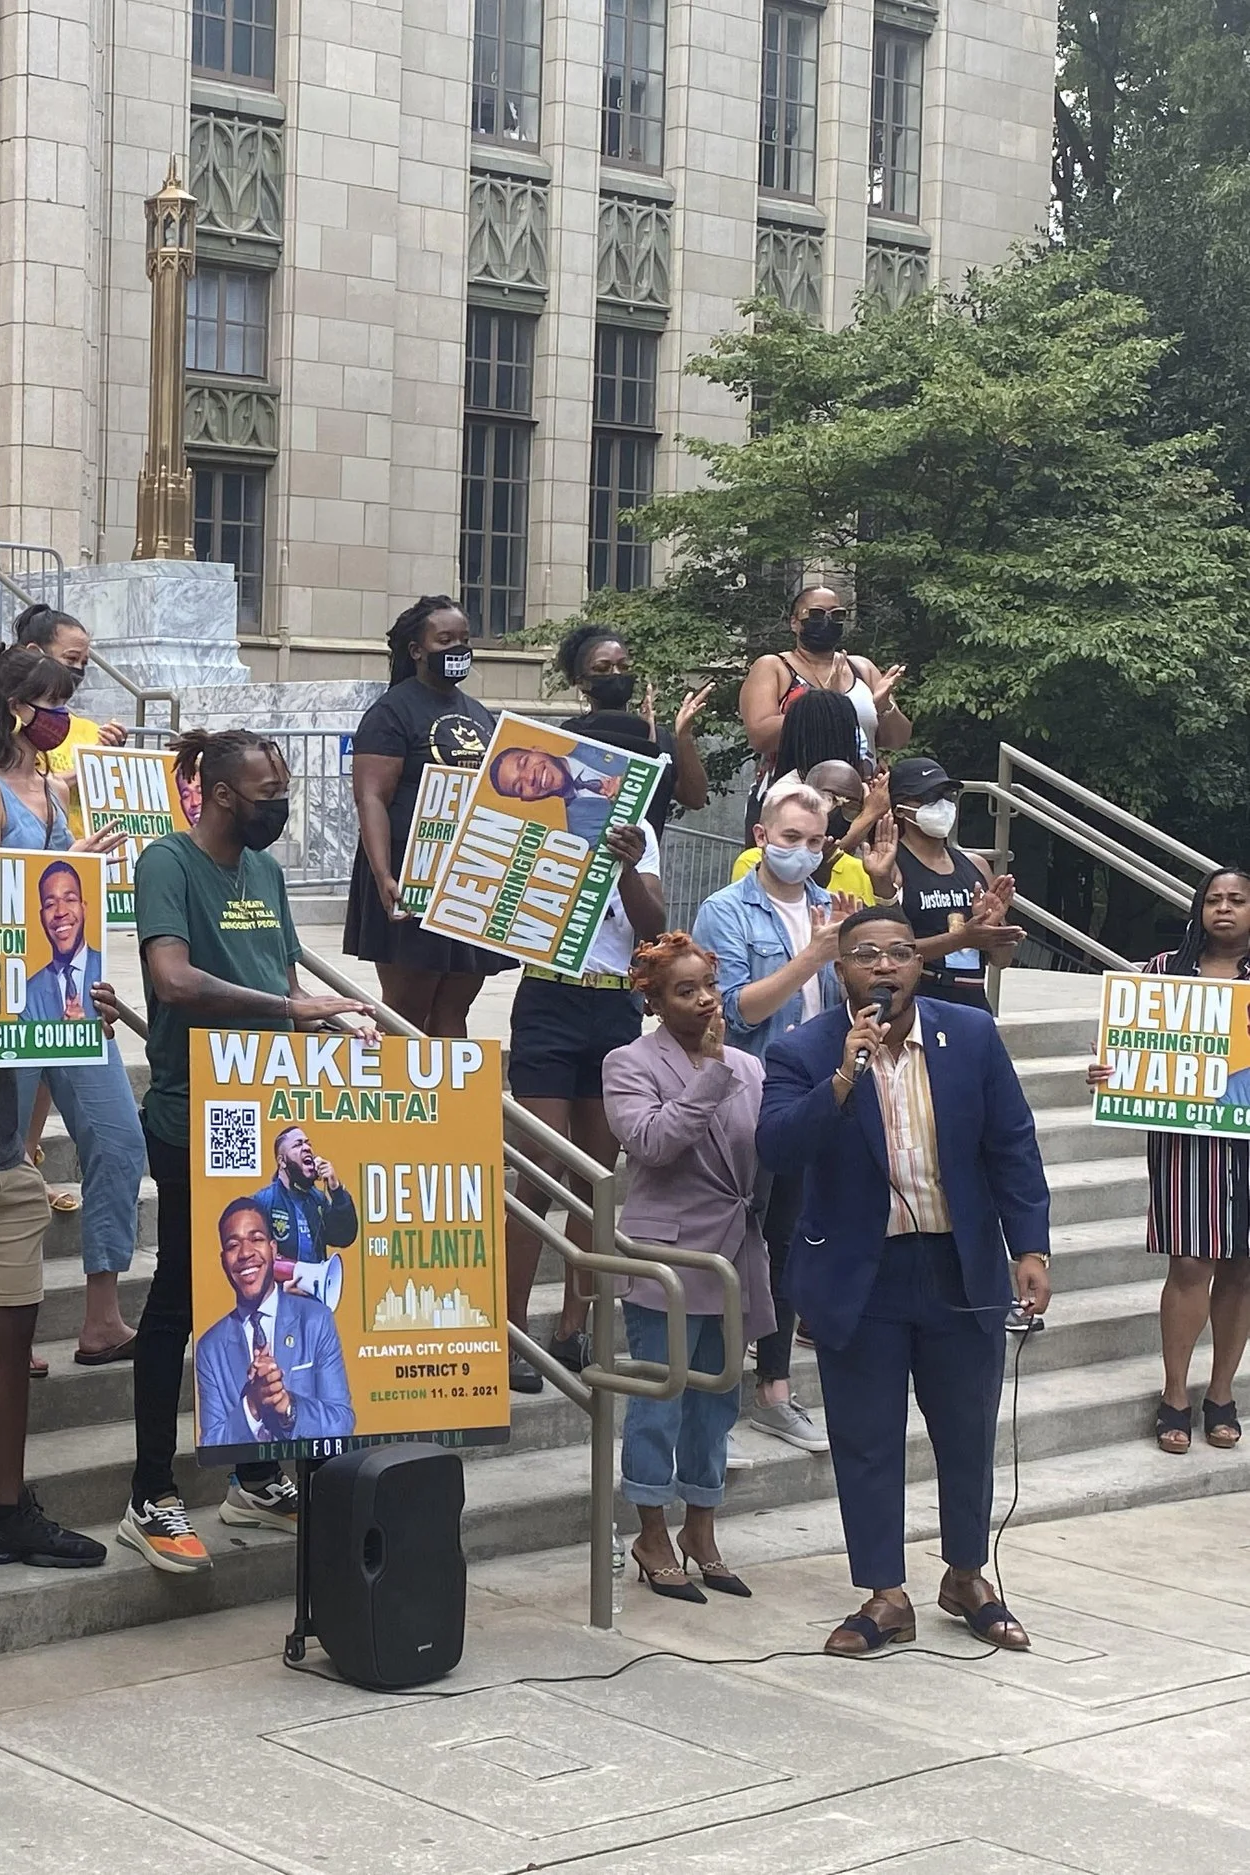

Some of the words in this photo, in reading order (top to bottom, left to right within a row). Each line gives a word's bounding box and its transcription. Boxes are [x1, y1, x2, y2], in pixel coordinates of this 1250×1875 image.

[82, 753, 171, 812] DEVIN
[432, 804, 525, 936] DEVIN
[484, 820, 549, 943] BARRINGTON
[506, 828, 590, 953] WARD
[919, 889, 951, 910] Justice
[950, 889, 964, 907] for
[555, 889, 600, 966] ATLANTA
[1108, 978, 1233, 1035] DEVIN
[34, 1023, 100, 1048] COUNCIL
[1107, 1028, 1229, 1056] BARRINGTON
[208, 1032, 383, 1088] WAKE
[406, 1039, 484, 1090] UP
[1106, 1049, 1229, 1099] WARD
[267, 1088, 439, 1123] ATLANTA!
[1100, 1096, 1178, 1120] ATLANTA
[1185, 1103, 1225, 1123] CITY
[366, 1163, 483, 1223] DEVIN
[368, 1237, 389, 1257] FOR
[390, 1229, 487, 1270] ATLANTA
[357, 1343, 413, 1358] ATLANTA
[416, 1342, 445, 1356] CITY
[447, 1340, 502, 1355] COUNCIL
[395, 1363, 458, 1379] DISTRICT
[461, 1362, 470, 1376] 9
[370, 1388, 427, 1402] ELECTION
[431, 1387, 448, 1399] 11.
[451, 1386, 468, 1398] 02.
[472, 1385, 498, 1397] 2021
